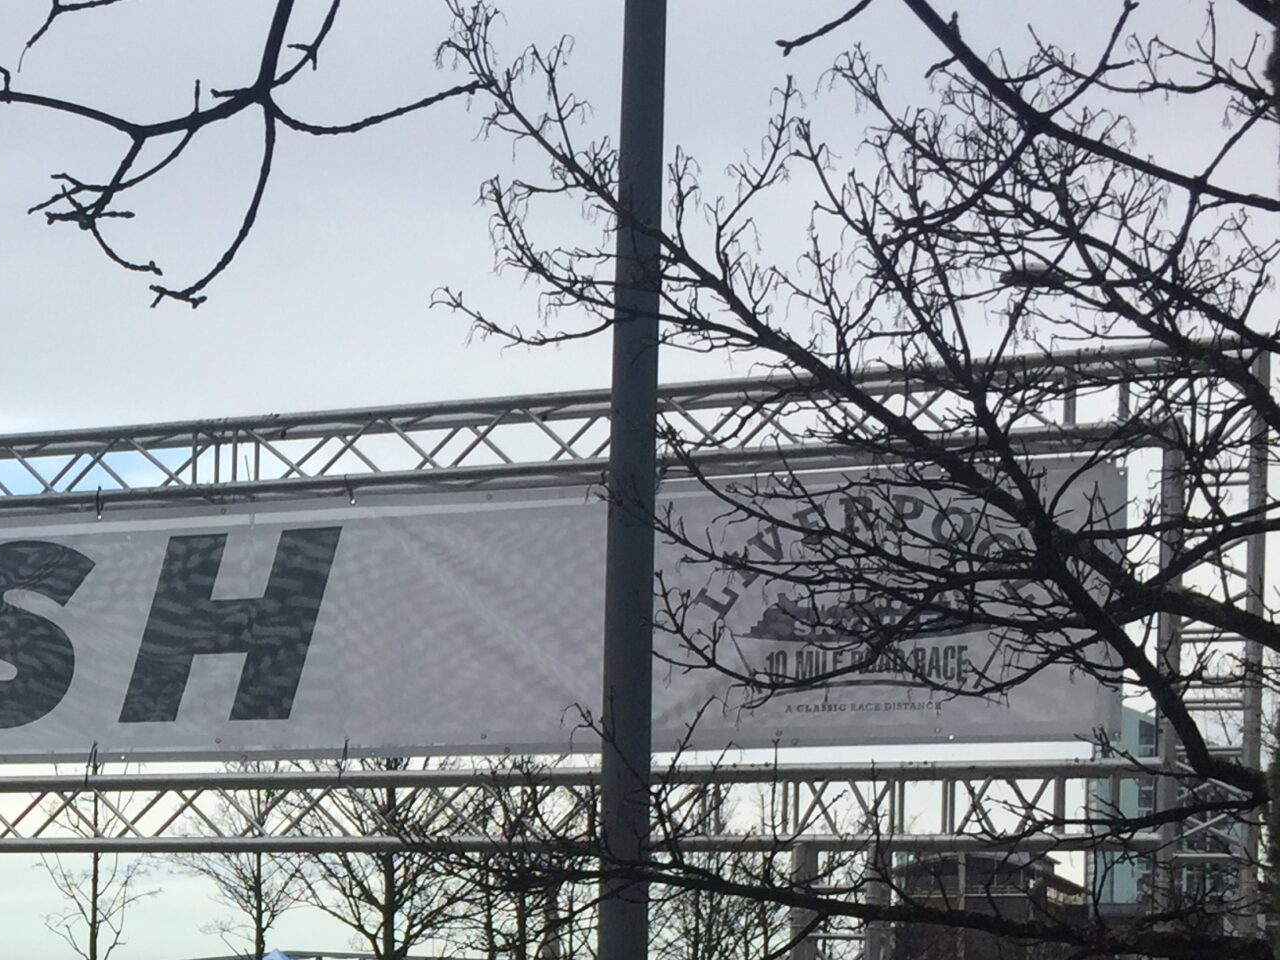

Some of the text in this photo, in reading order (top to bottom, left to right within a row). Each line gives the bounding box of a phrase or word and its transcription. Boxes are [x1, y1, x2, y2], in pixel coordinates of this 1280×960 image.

[765, 651, 787, 684] 10
[912, 646, 969, 684] RACE
[796, 703, 847, 713] CLASSIC
